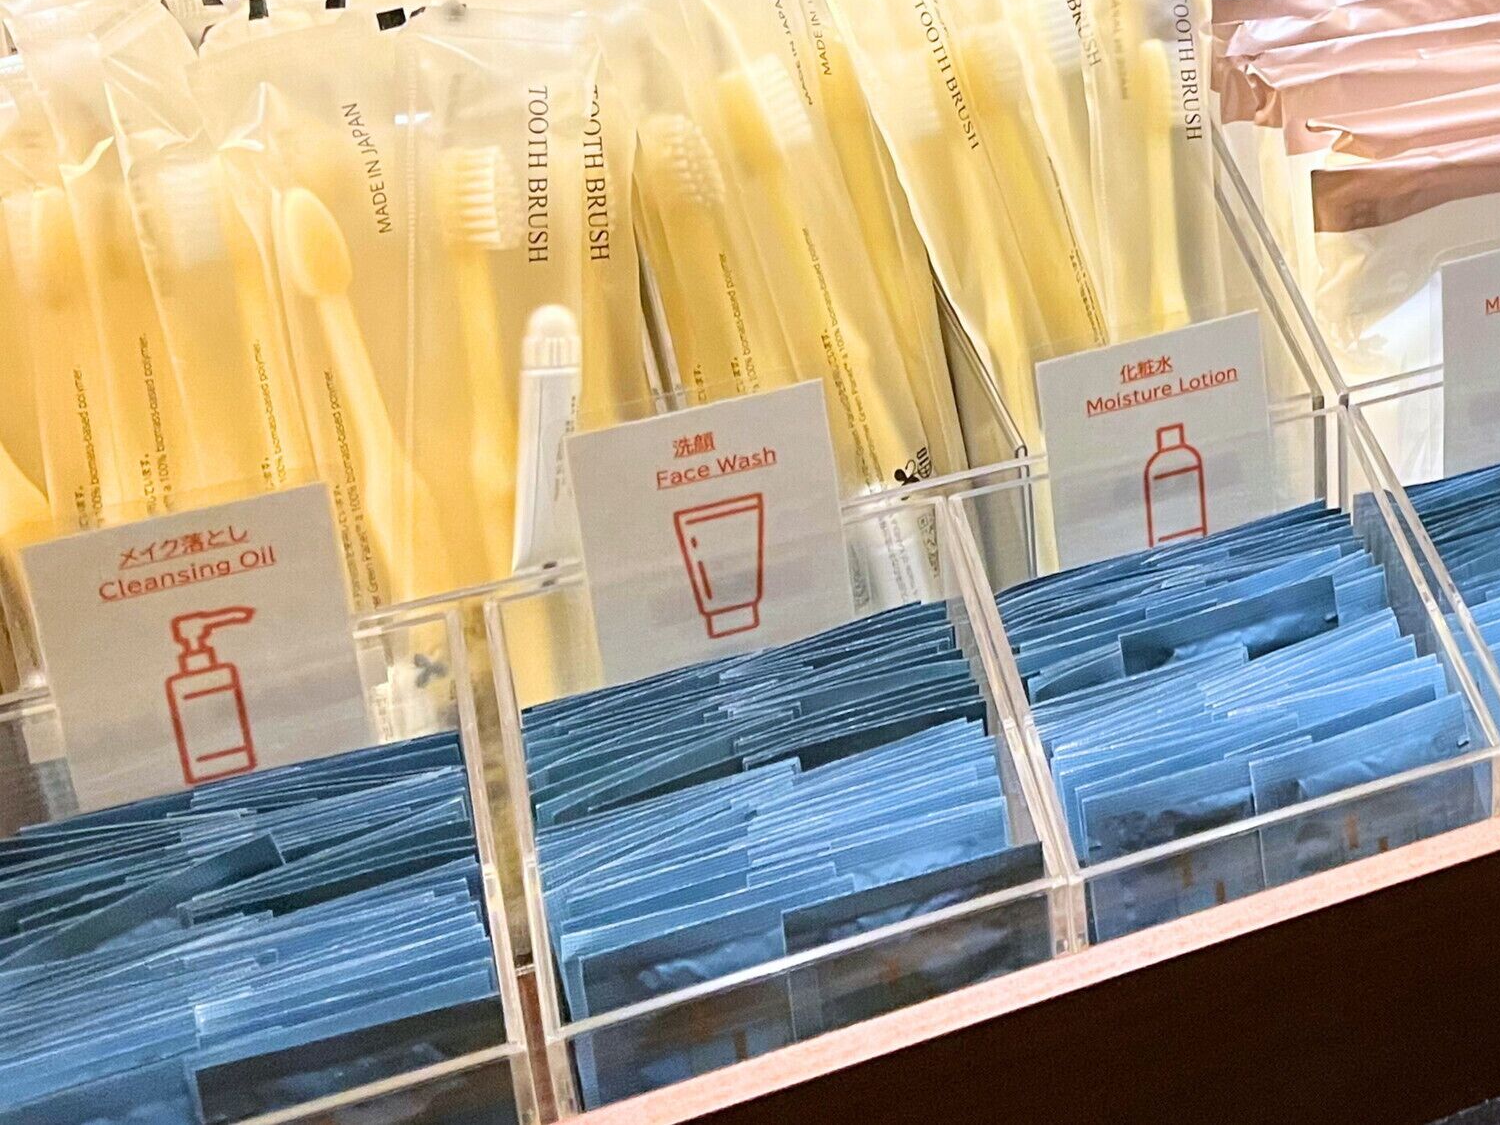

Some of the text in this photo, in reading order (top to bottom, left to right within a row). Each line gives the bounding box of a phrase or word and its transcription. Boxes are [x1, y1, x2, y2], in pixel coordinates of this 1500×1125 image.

[809, 11, 821, 26] IN
[813, 30, 832, 75] MADE
[945, 76, 981, 150] BRUSH
[1180, 69, 1203, 141] BRUSH
[341, 102, 393, 234] MADE IN JAPAN
[528, 84, 549, 263] TOOTH BRUSH
[585, 177, 610, 261] BRUSH
[1086, 367, 1238, 416] Moisture Lotion
[1120, 355, 1173, 383] 化粧水
[656, 447, 777, 490] Face Wash
[672, 431, 716, 458] 洗顔
[120, 525, 249, 570] メイク落とし
[99, 545, 277, 602] Cleansing Oil
